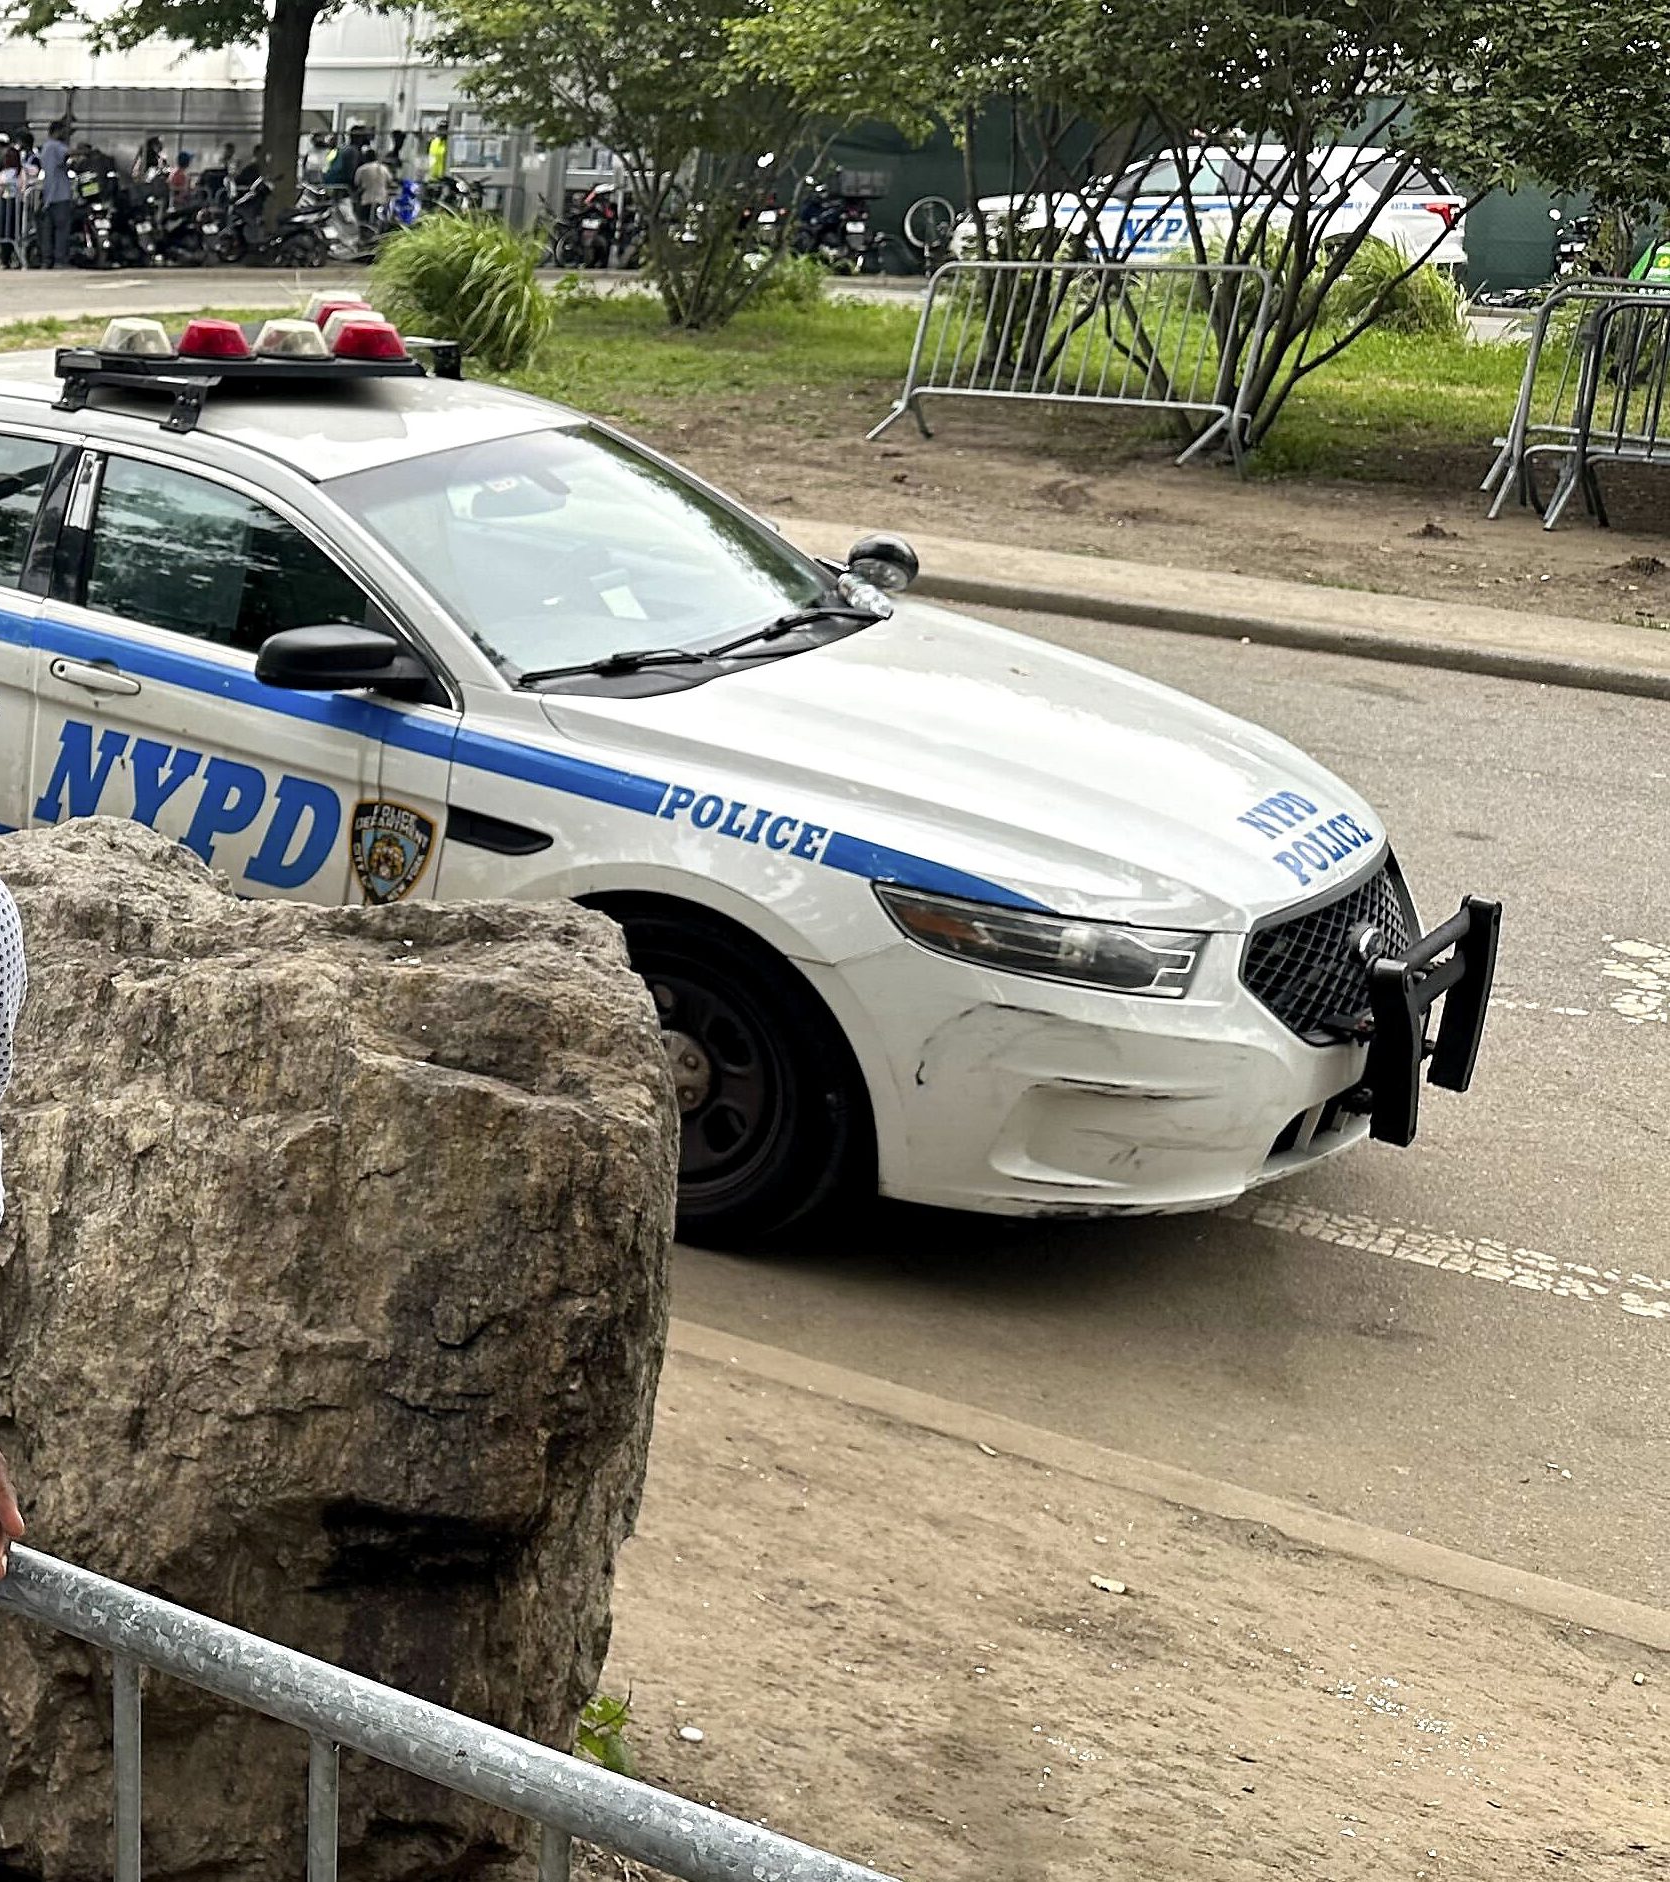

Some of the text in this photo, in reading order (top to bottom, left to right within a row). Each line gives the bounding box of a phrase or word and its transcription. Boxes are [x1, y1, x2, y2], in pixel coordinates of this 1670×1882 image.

[33, 719, 342, 889] NYPD
[660, 785, 828, 861] POLICE
[1237, 791, 1318, 840] NYPD
[1273, 813, 1373, 886] POLICE
